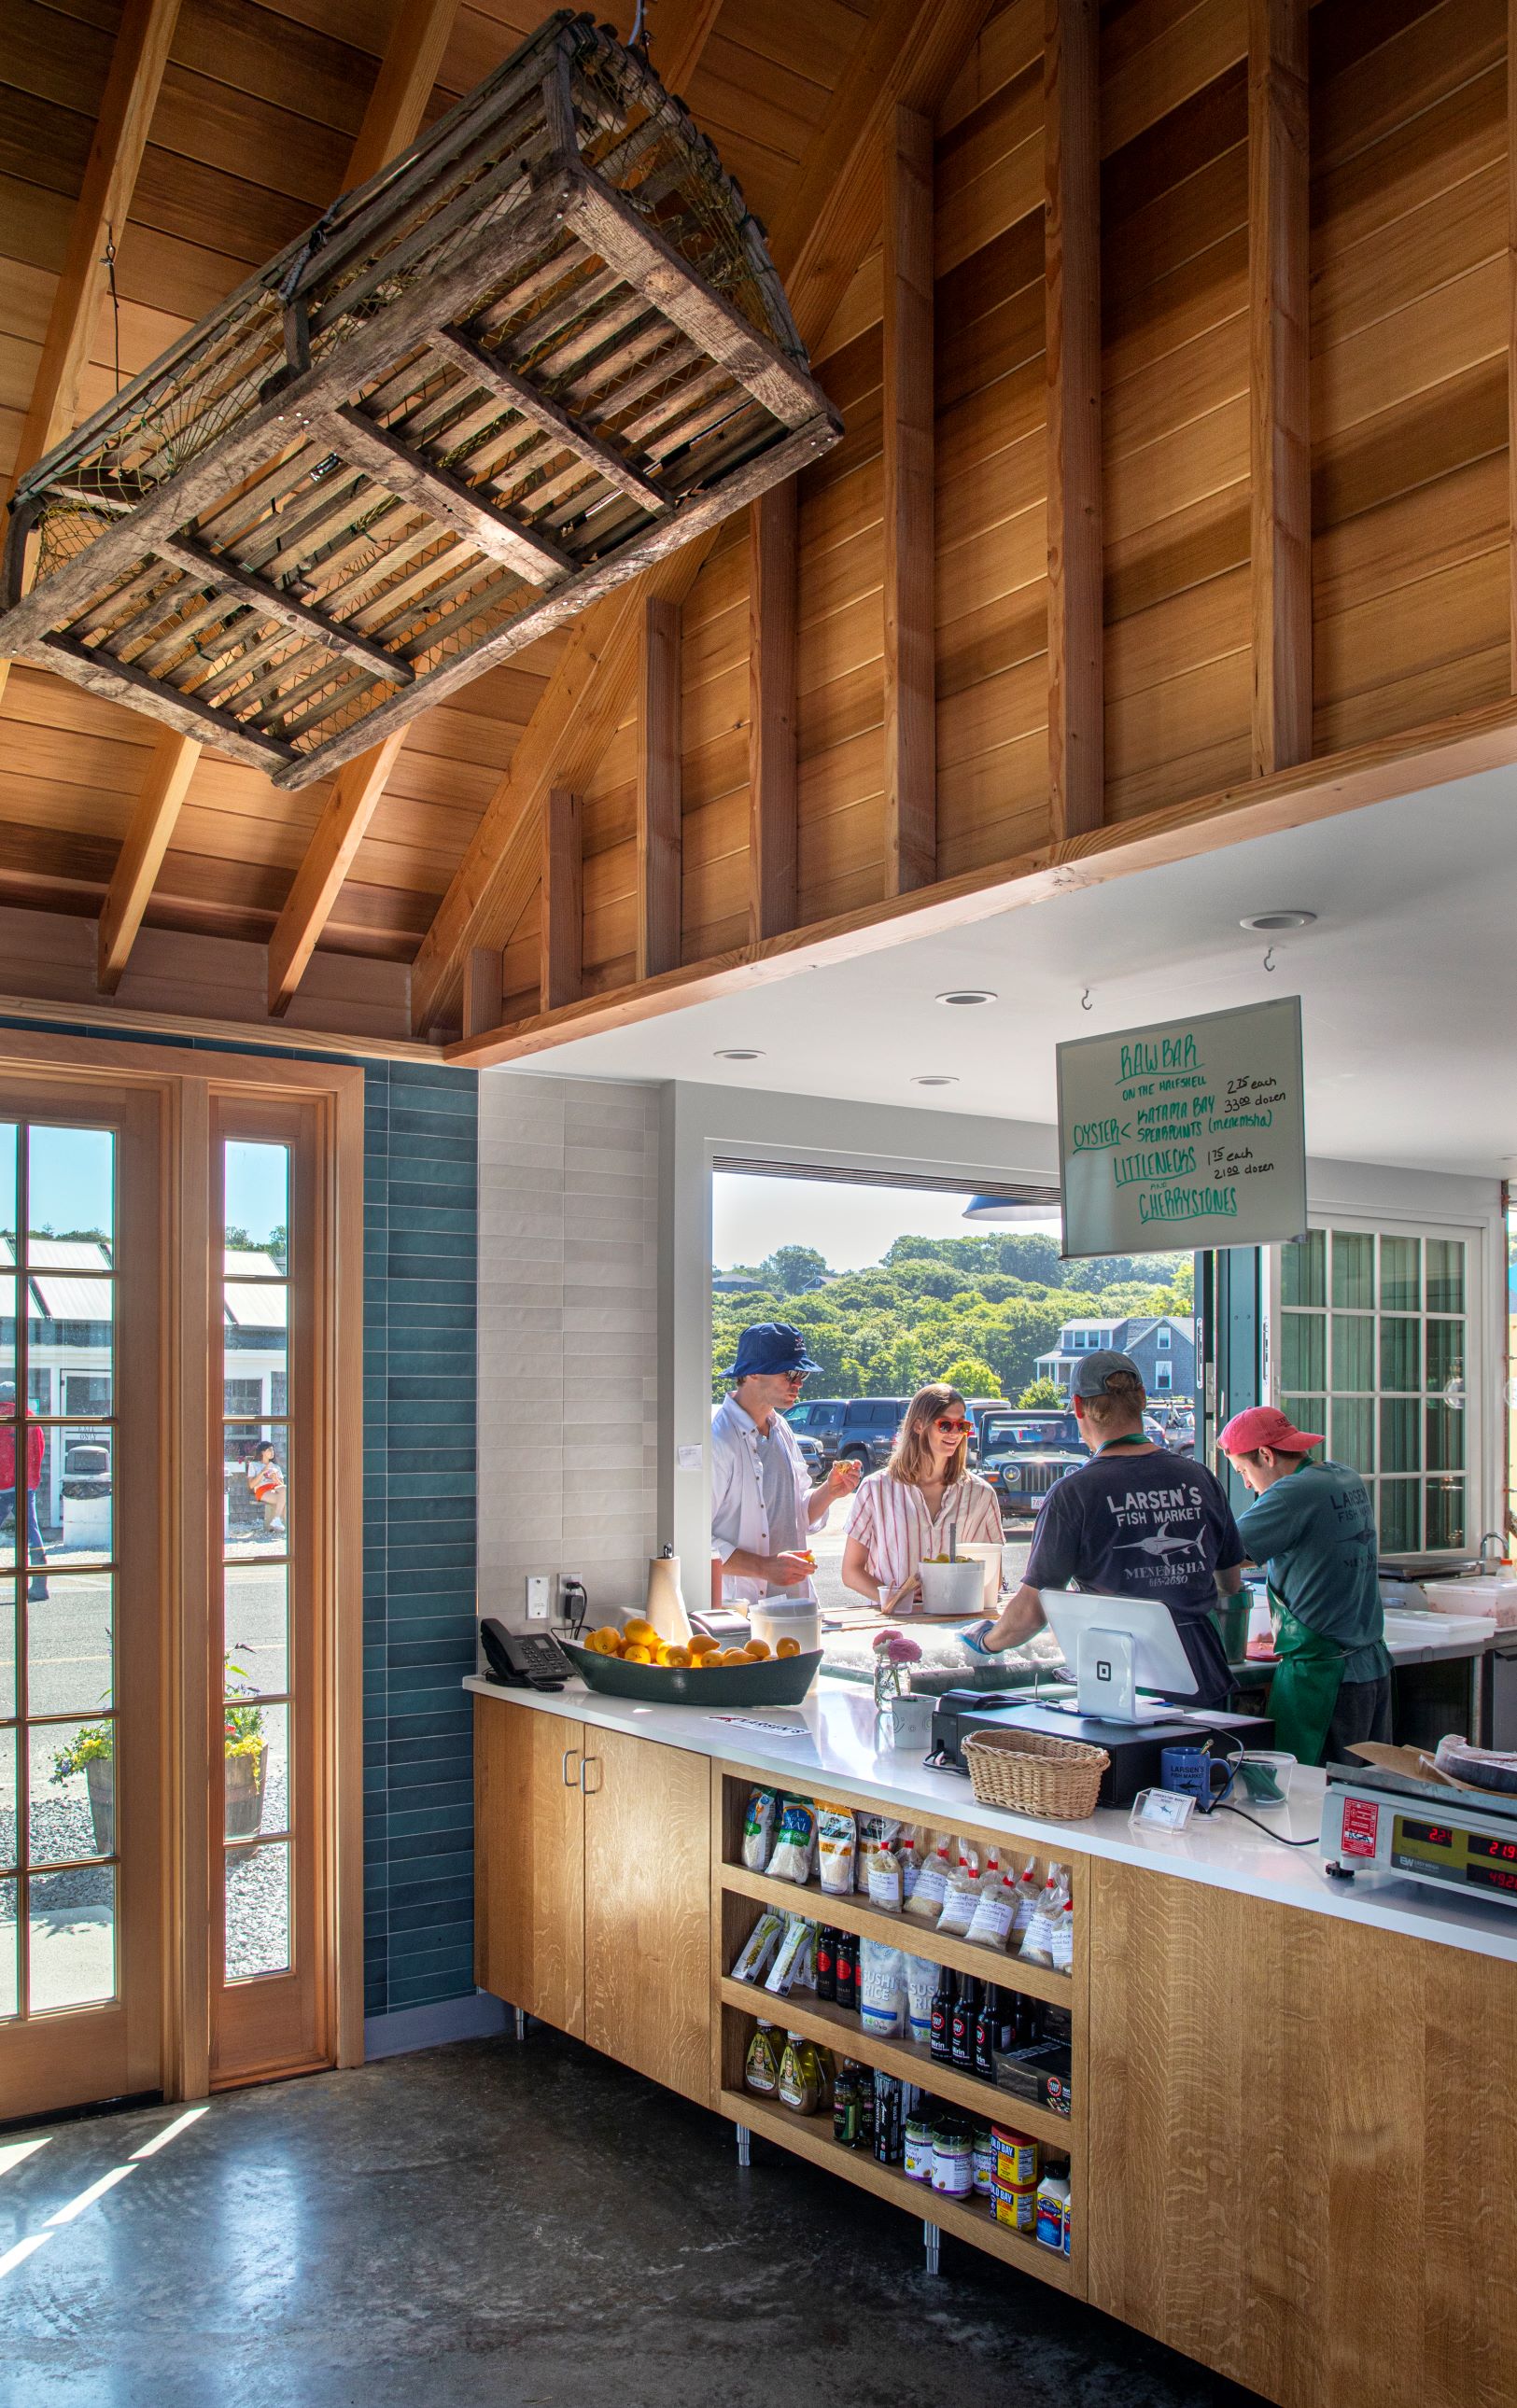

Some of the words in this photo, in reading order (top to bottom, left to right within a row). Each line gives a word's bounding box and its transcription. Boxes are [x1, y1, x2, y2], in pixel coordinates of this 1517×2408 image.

[1121, 1043, 1158, 1078] RAW
[1162, 1033, 1196, 1068] BAR
[1122, 1087, 1135, 1100] ON
[1138, 1084, 1155, 1097] THE
[1159, 1075, 1206, 1090] HALFSHELL
[1251, 1077, 1277, 1090] each
[1255, 1092, 1286, 1106] dozen
[1138, 1102, 1187, 1125] KATAMA
[1193, 1095, 1215, 1117] BAY
[1074, 1119, 1119, 1147] OYSTER
[1227, 1147, 1253, 1162] each
[1114, 1146, 1197, 1183] LITTLENECKS
[1244, 1162, 1274, 1174] dozen
[1150, 1182, 1167, 1190] AND
[1139, 1187, 1238, 1219] CHERRYSTONES
[1106, 1483, 1202, 1513] LARSEN'S
[1117, 1512, 1146, 1527] FISH
[1154, 1506, 1201, 1523] MARKET
[1124, 1561, 1206, 1580] MENEMSHA
[1489, 1841, 1517, 1859] 21.9
[864, 1970, 895, 1990] SUSHI
[909, 1982, 934, 1996] SUS
[864, 1984, 890, 2001] RICE
[991, 2136, 1001, 2150] OLD
[1002, 2143, 1013, 2157] BAY
[1000, 2190, 1012, 2204] BAY
